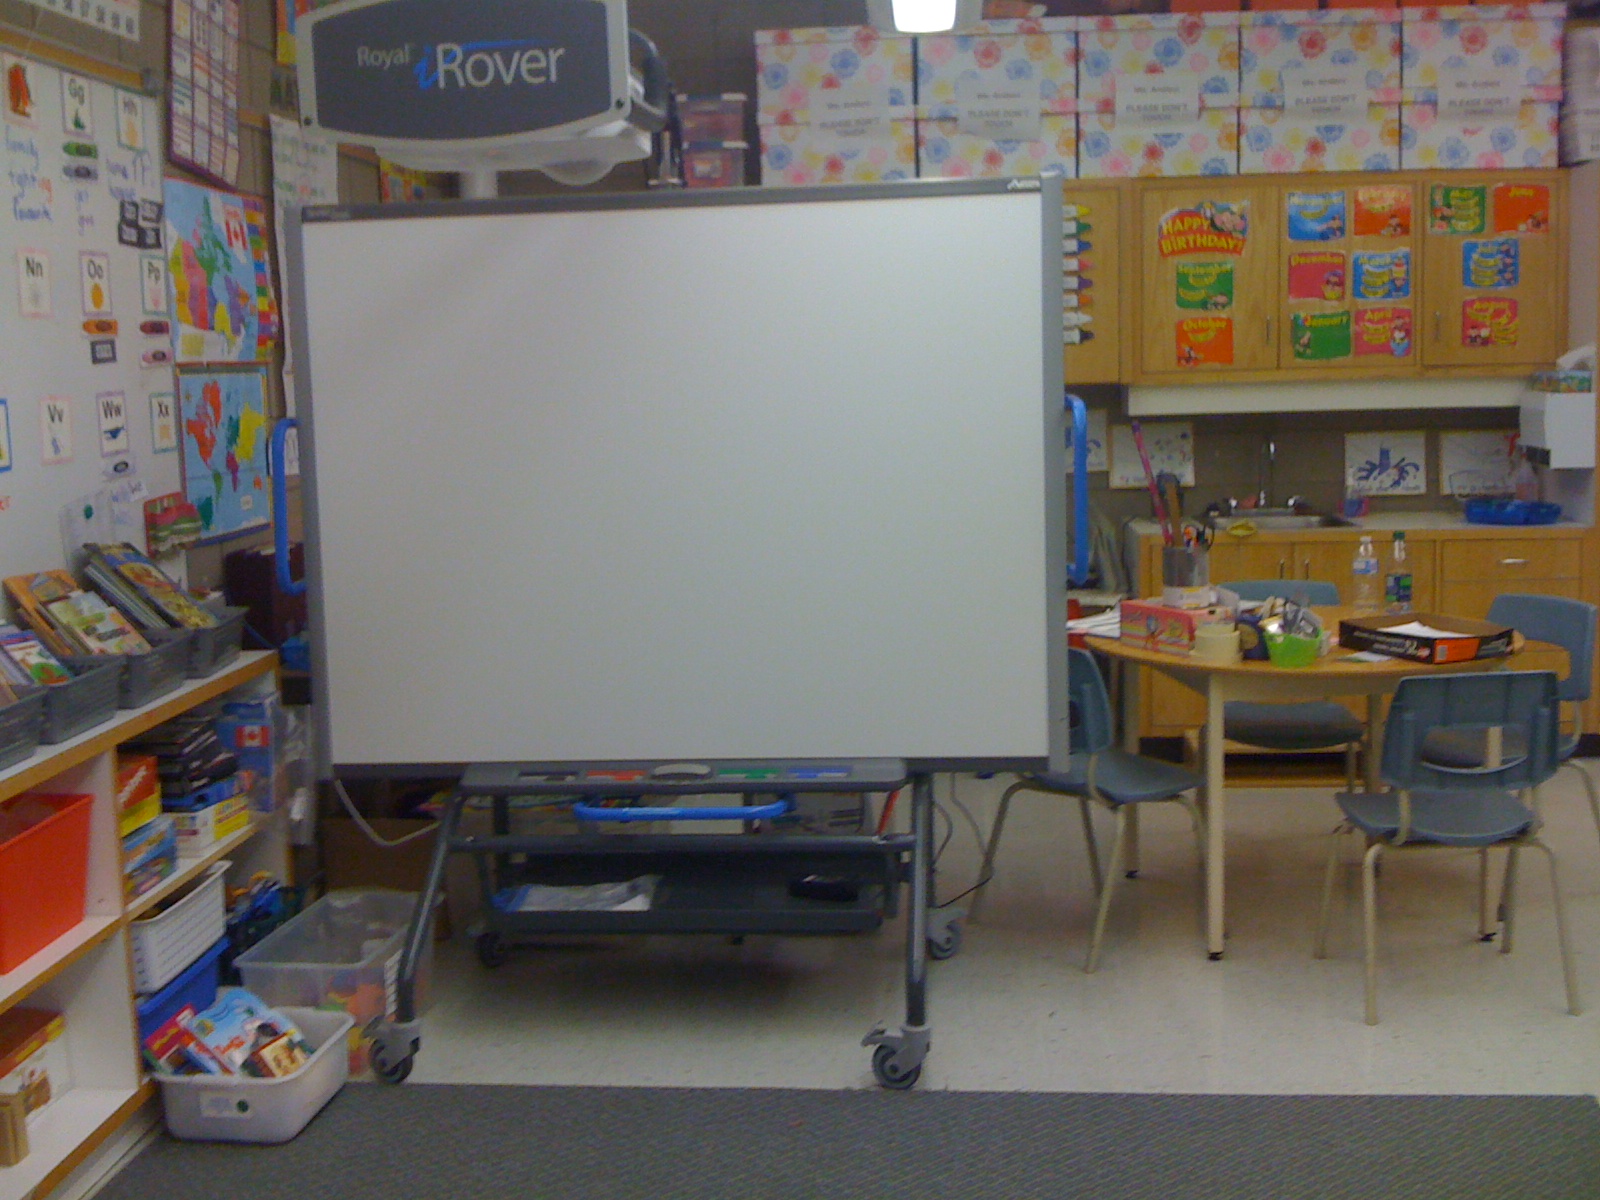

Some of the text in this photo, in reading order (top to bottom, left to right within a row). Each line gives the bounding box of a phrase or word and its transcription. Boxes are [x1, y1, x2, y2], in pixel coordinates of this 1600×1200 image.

[356, 40, 567, 90] Royal iRover
[1162, 216, 1210, 236] HAPPY
[1161, 234, 1244, 254] BIRTHDAY!
[26, 257, 43, 277] Nn
[87, 259, 103, 279] Oo
[47, 404, 64, 423] Vv
[102, 400, 122, 419] Ww
[157, 401, 170, 418] Xx
